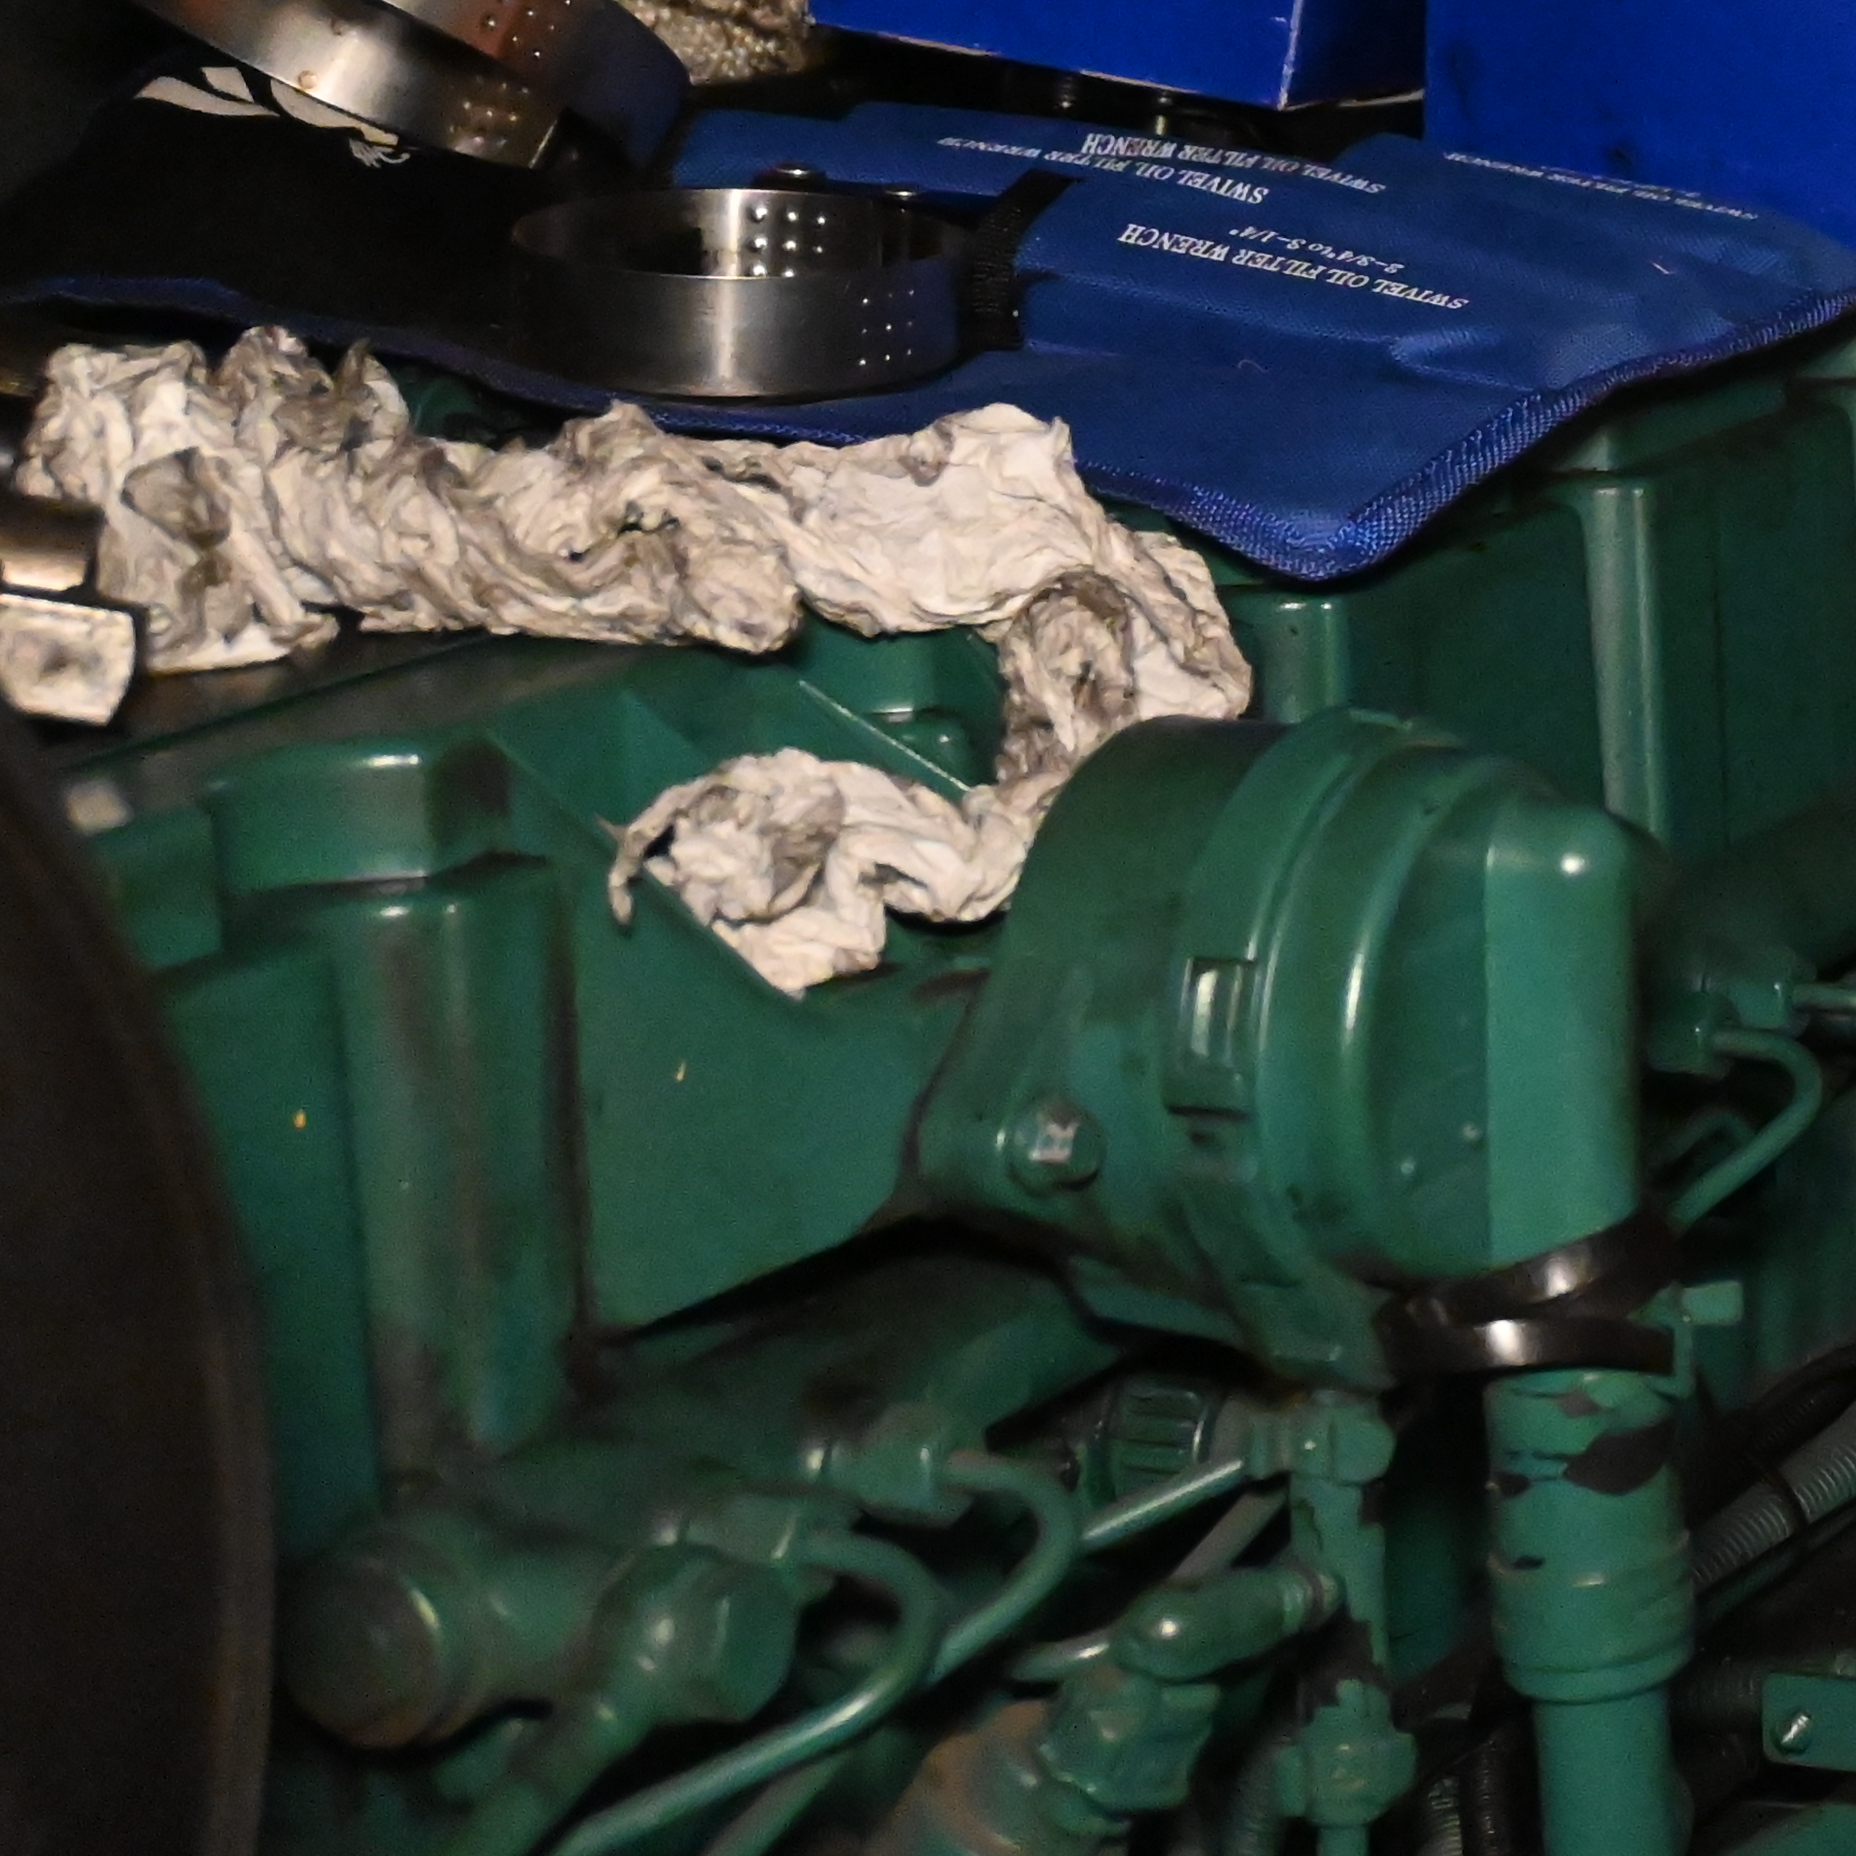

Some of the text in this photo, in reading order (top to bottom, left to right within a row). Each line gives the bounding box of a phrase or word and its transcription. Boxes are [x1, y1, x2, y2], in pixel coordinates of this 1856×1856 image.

[1081, 133, 1178, 161] WRENCH
[1135, 161, 1175, 180] OIL
[1176, 169, 1269, 204] SWIVEL
[1117, 223, 1469, 309] SWIVEL OIL FILTER WRENCH
